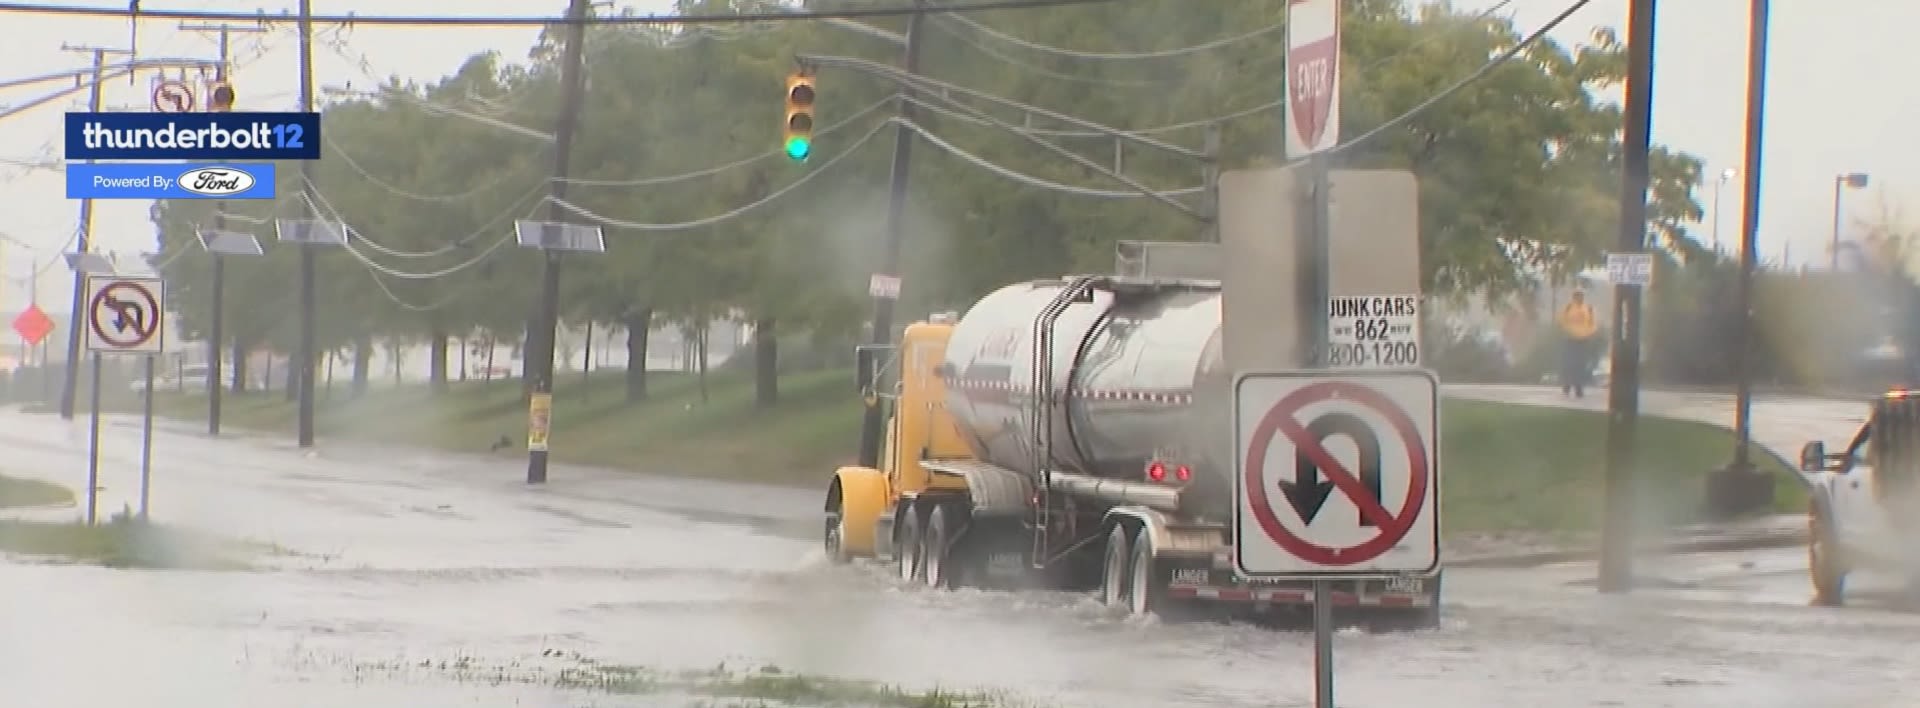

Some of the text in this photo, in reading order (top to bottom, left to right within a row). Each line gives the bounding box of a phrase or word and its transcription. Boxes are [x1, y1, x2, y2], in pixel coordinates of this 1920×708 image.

[1297, 58, 1328, 101] ENTER
[1329, 296, 1415, 317] JUNK CARS
[1355, 318, 1388, 341] 862
[1329, 341, 1417, 366] 800-1200
